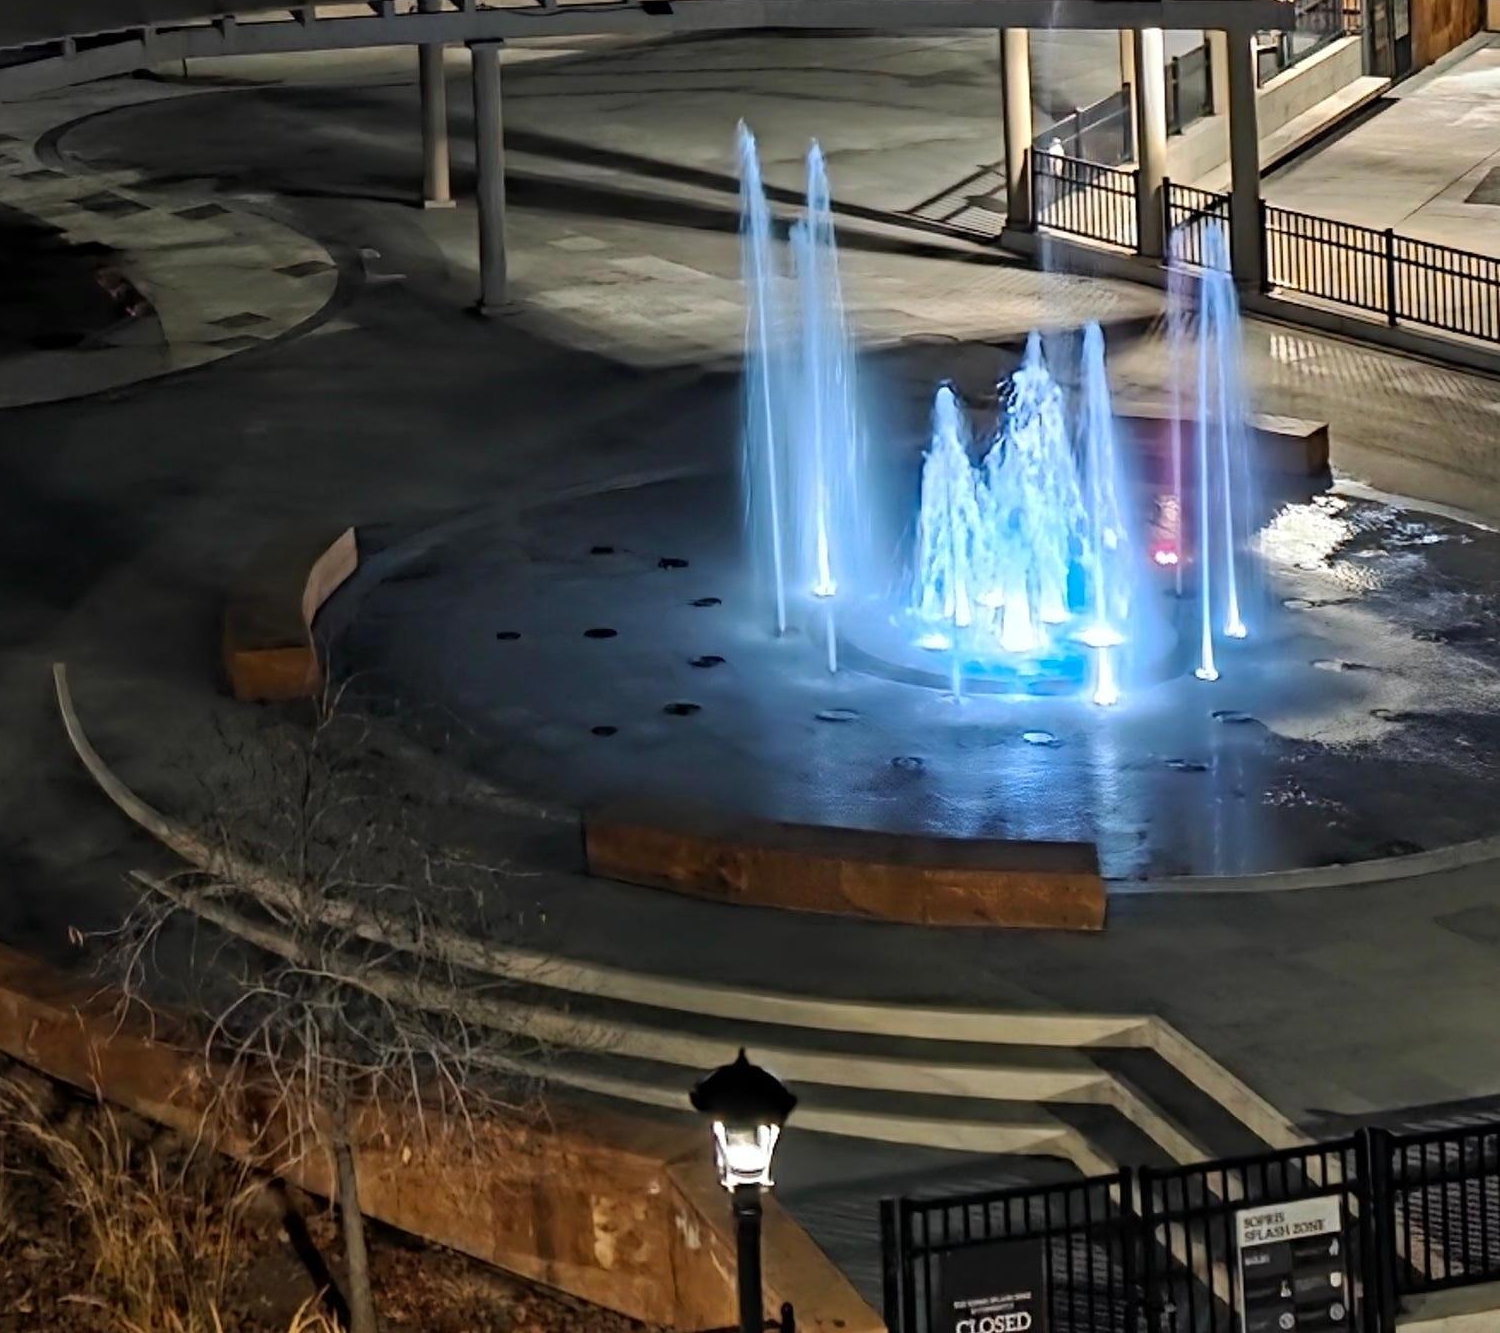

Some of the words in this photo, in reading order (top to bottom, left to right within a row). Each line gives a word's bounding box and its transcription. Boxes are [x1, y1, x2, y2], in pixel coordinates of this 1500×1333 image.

[1244, 1224, 1290, 1242] SPLASH
[1293, 1219, 1325, 1234] ZONE
[956, 1311, 1032, 1333] CLOSED
